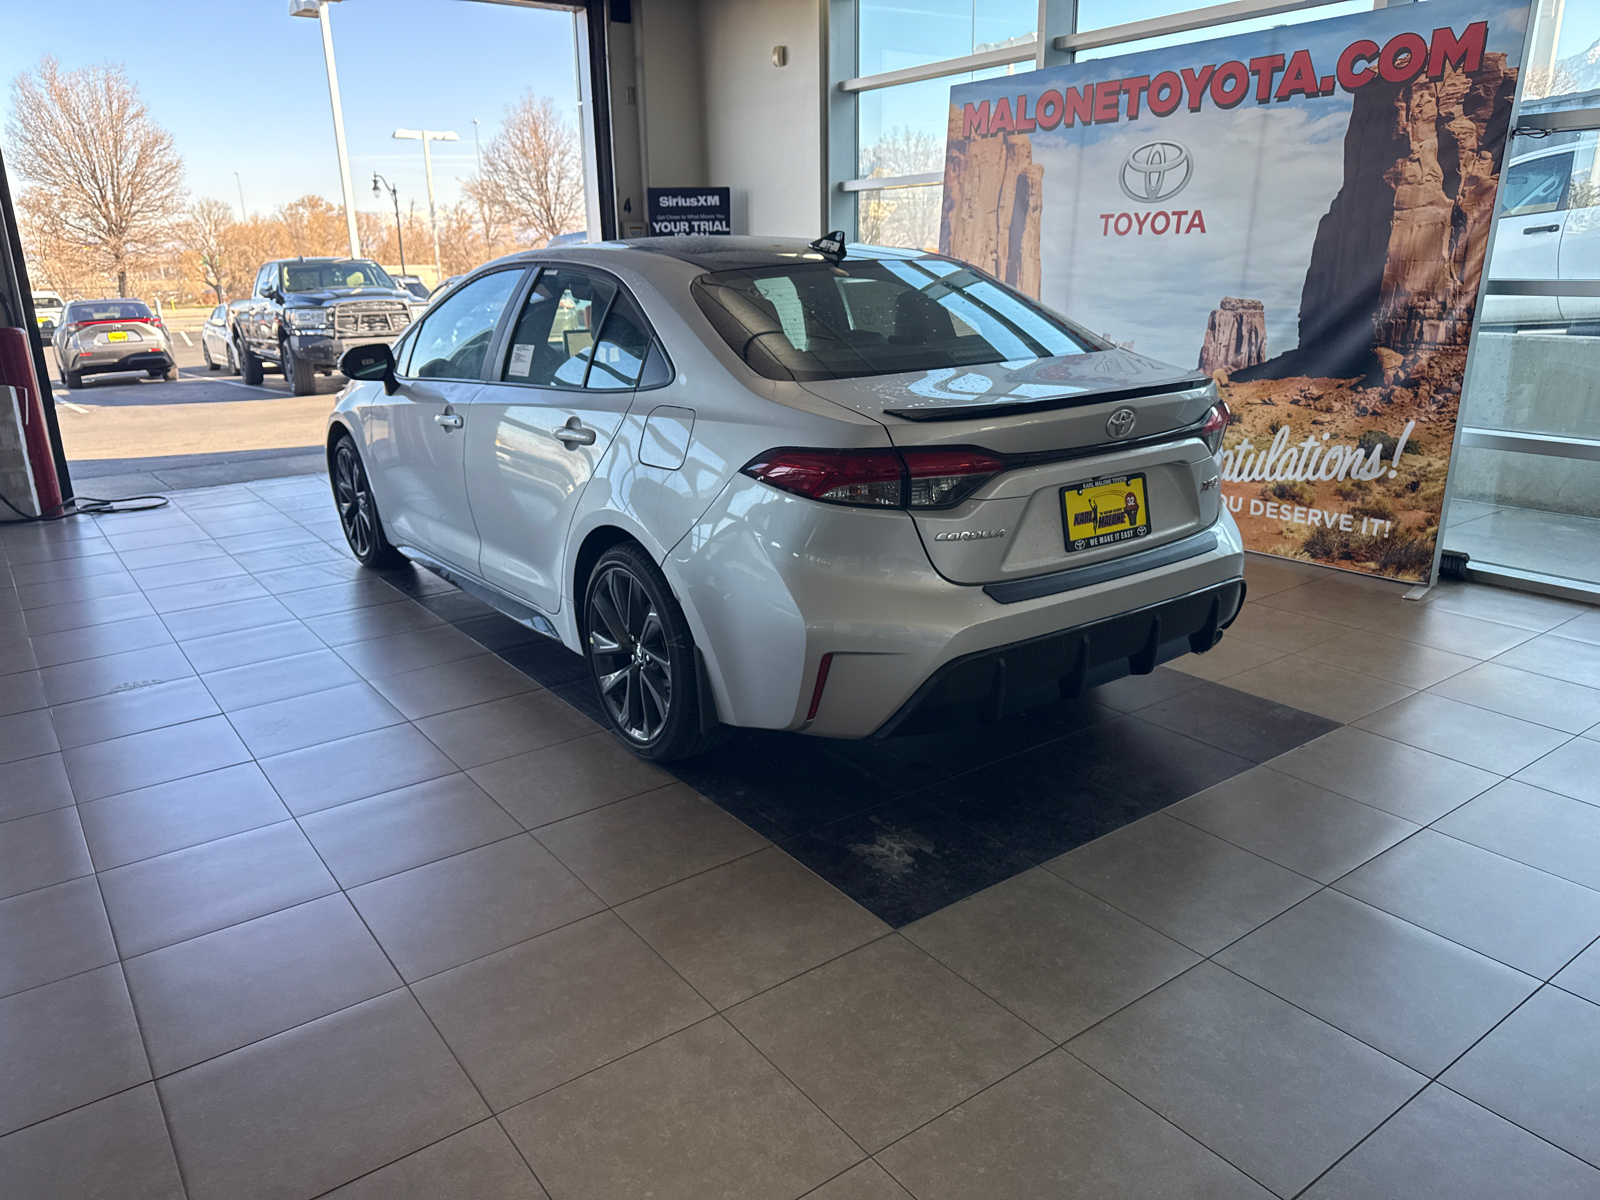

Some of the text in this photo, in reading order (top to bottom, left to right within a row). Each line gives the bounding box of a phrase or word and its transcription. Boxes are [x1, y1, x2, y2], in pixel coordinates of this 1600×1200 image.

[962, 20, 1489, 139] MALONETOYOTA.COM
[623, 198, 632, 214] 4
[658, 195, 720, 207] SiriusXM
[652, 221, 690, 233] YOUR
[691, 220, 730, 232] TRIAL
[1100, 209, 1206, 236] TOYOTA
[1221, 420, 1416, 482] atulations!
[1095, 478, 1111, 486] MALONE
[1112, 476, 1127, 484] TOYOTA
[1126, 496, 1135, 506] 32
[1073, 510, 1094, 526] KARL
[1098, 512, 1126, 529] MALONE
[1249, 498, 1354, 532] DESERVE
[1361, 517, 1392, 539] IT!
[934, 528, 1006, 541] COROLLA
[1089, 531, 1133, 546] WE MAKE IT EASY
